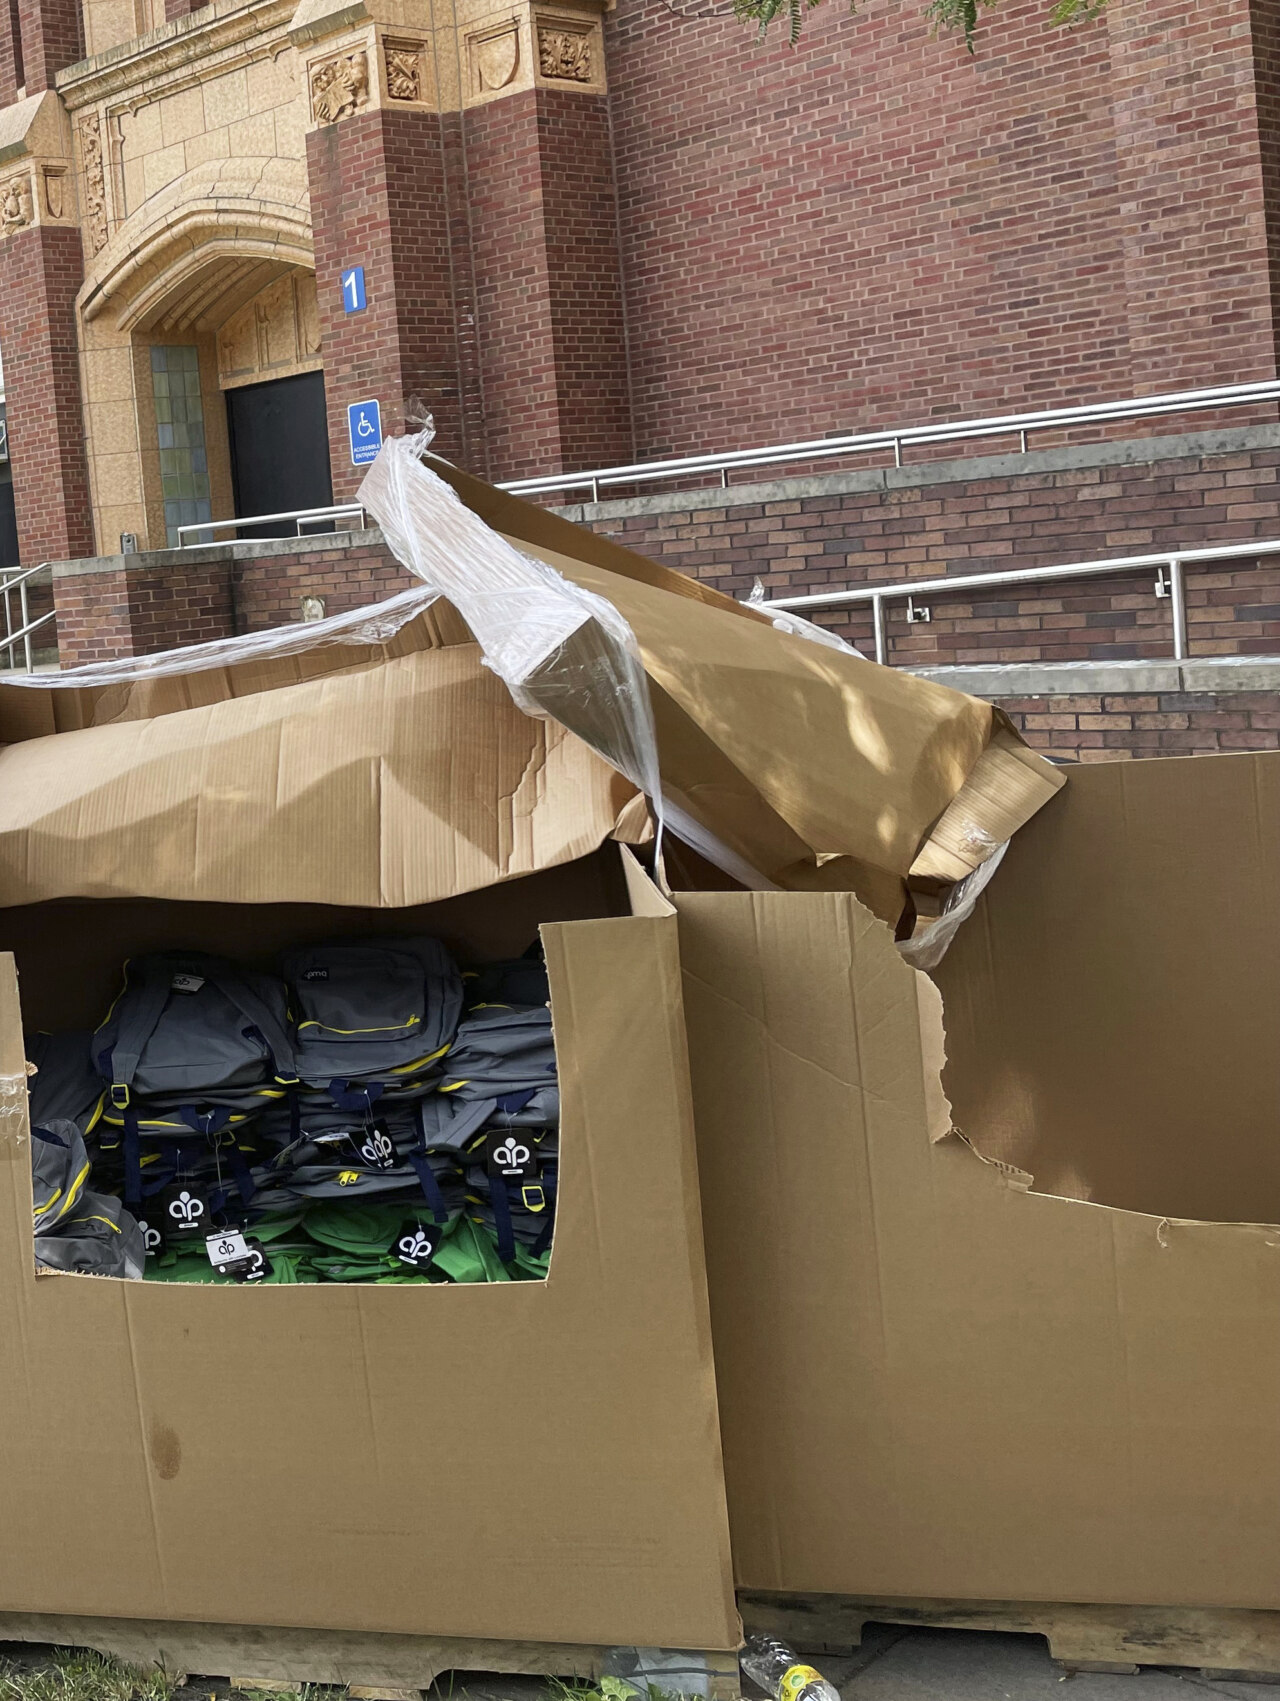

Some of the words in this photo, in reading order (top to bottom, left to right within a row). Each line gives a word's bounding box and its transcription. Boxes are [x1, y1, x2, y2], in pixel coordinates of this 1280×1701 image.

[344, 271, 358, 309] 1
[354, 443, 380, 452] ACCESSIBLE
[355, 450, 379, 460] ENTRANC
